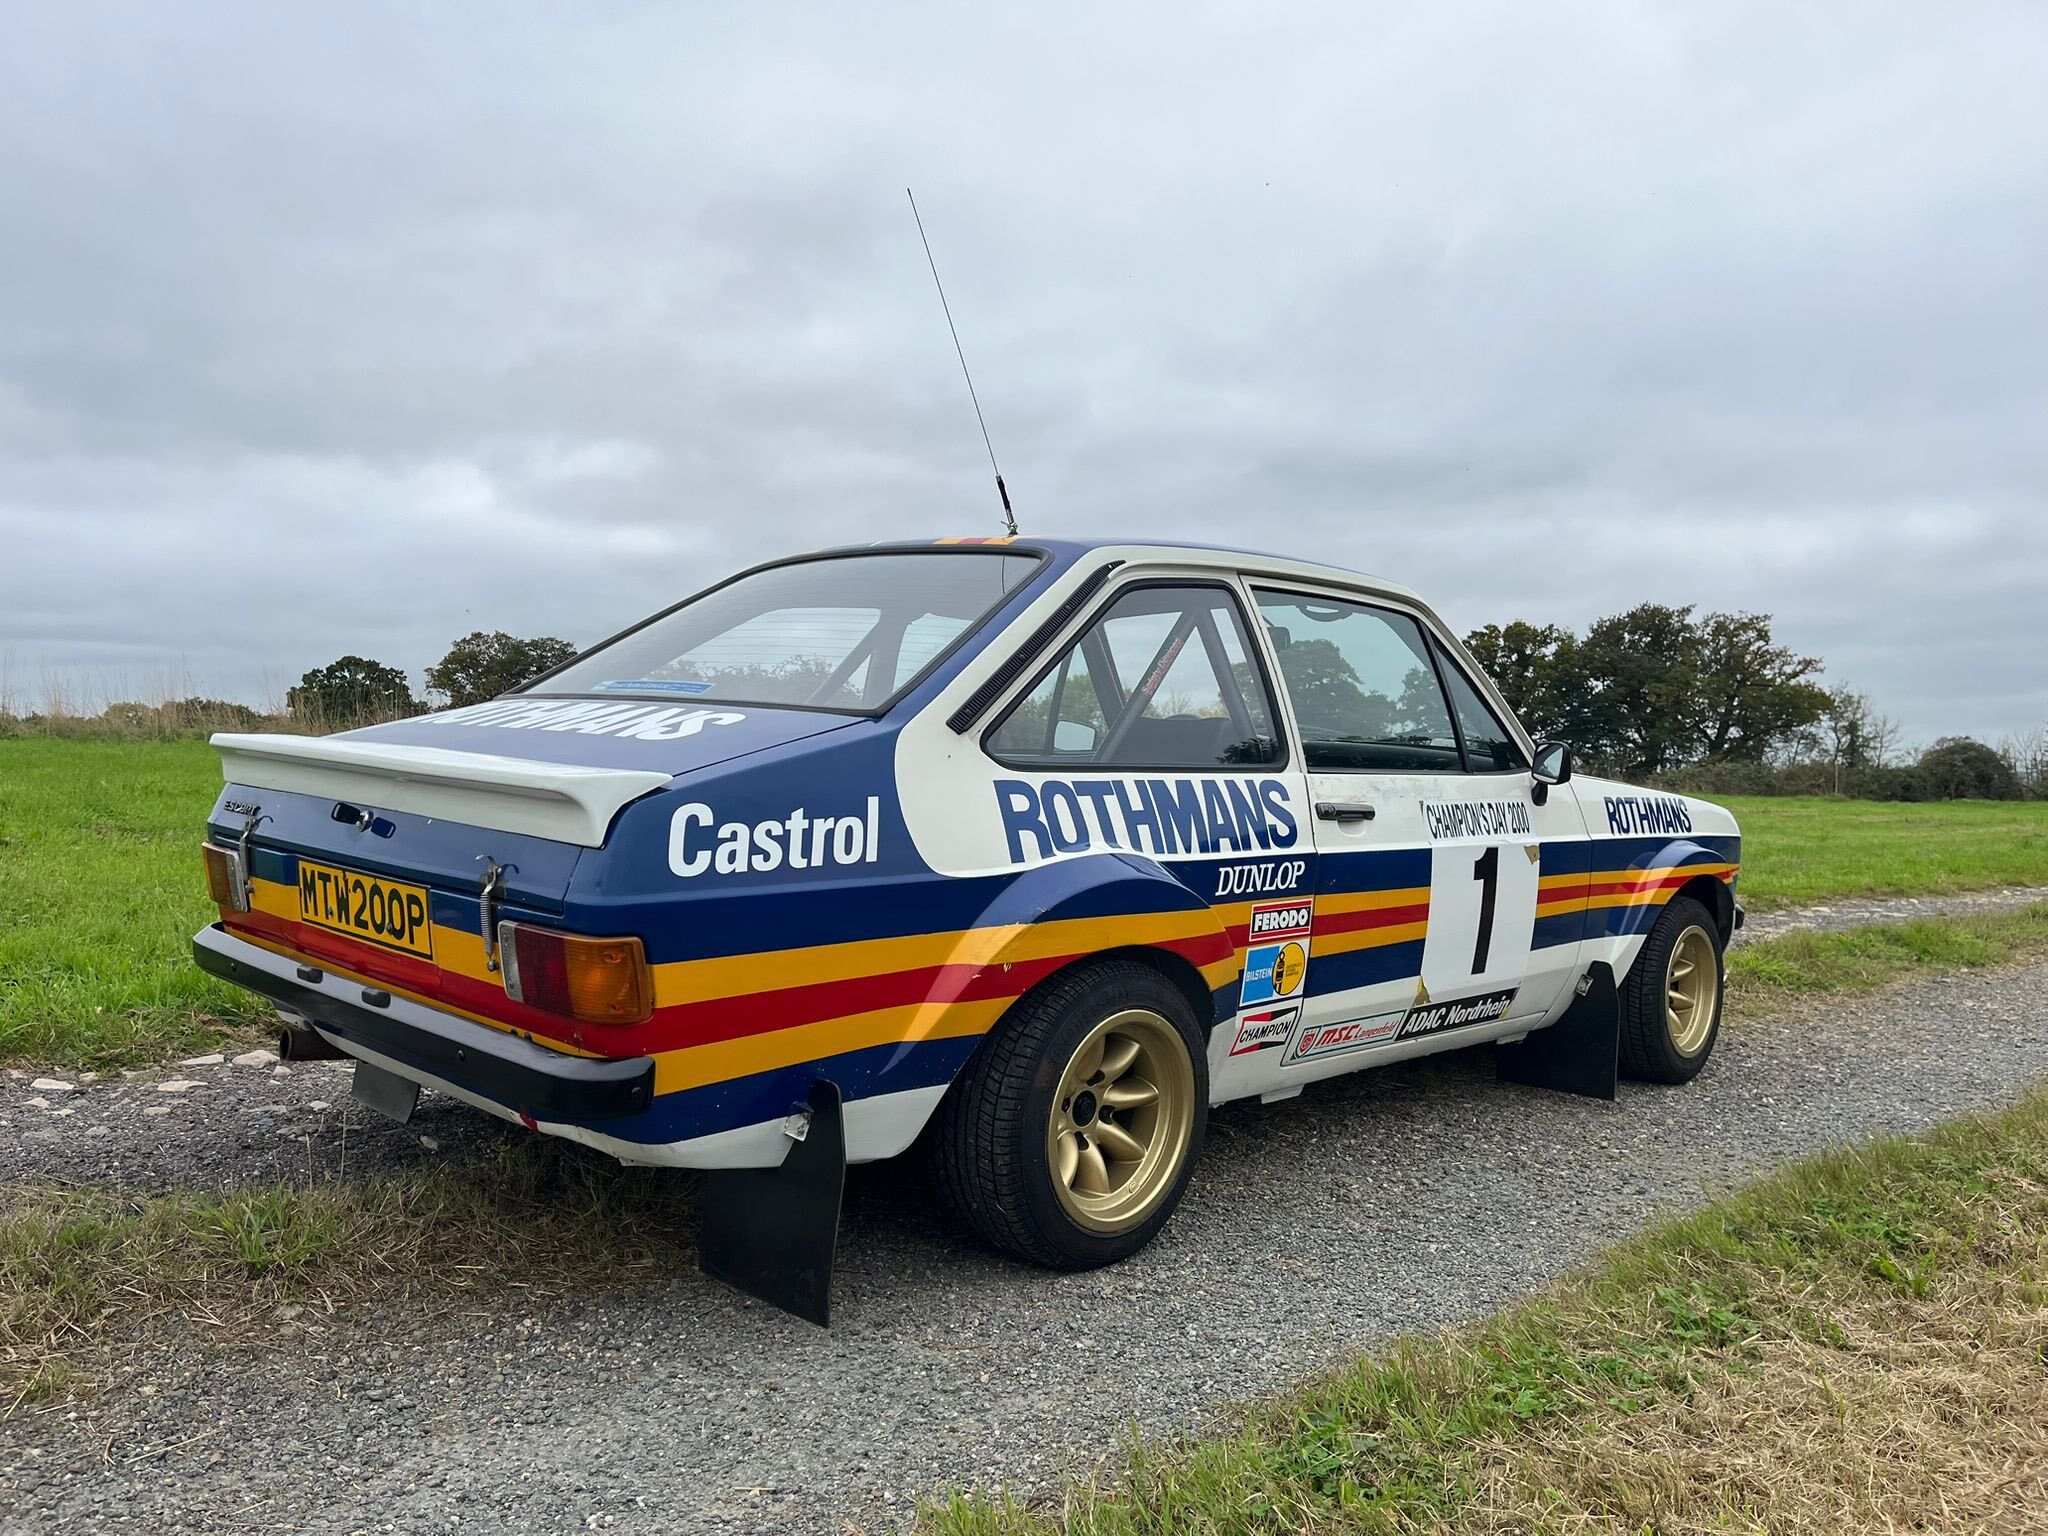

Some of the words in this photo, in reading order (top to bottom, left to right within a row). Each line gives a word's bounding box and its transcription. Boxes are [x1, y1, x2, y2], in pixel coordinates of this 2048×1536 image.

[224, 800, 261, 816] ESCORT
[993, 779, 1298, 864] ROTHMANS
[1426, 802, 1491, 840] CHAMPION'S
[1487, 802, 1509, 835] DAY
[1507, 802, 1530, 834] 2000
[1604, 796, 1692, 836] ROTHMANS
[668, 796, 879, 877] Castrol
[1215, 860, 1305, 897] DUNLOP
[1253, 908, 1309, 932] FERODO
[1471, 847, 1498, 975] 1
[1245, 967, 1273, 982] BILSTEIN
[1239, 1020, 1292, 1044] CHAMPION
[1401, 1006, 1446, 1035] ADAC
[1443, 995, 1511, 1026] Nordrhein
